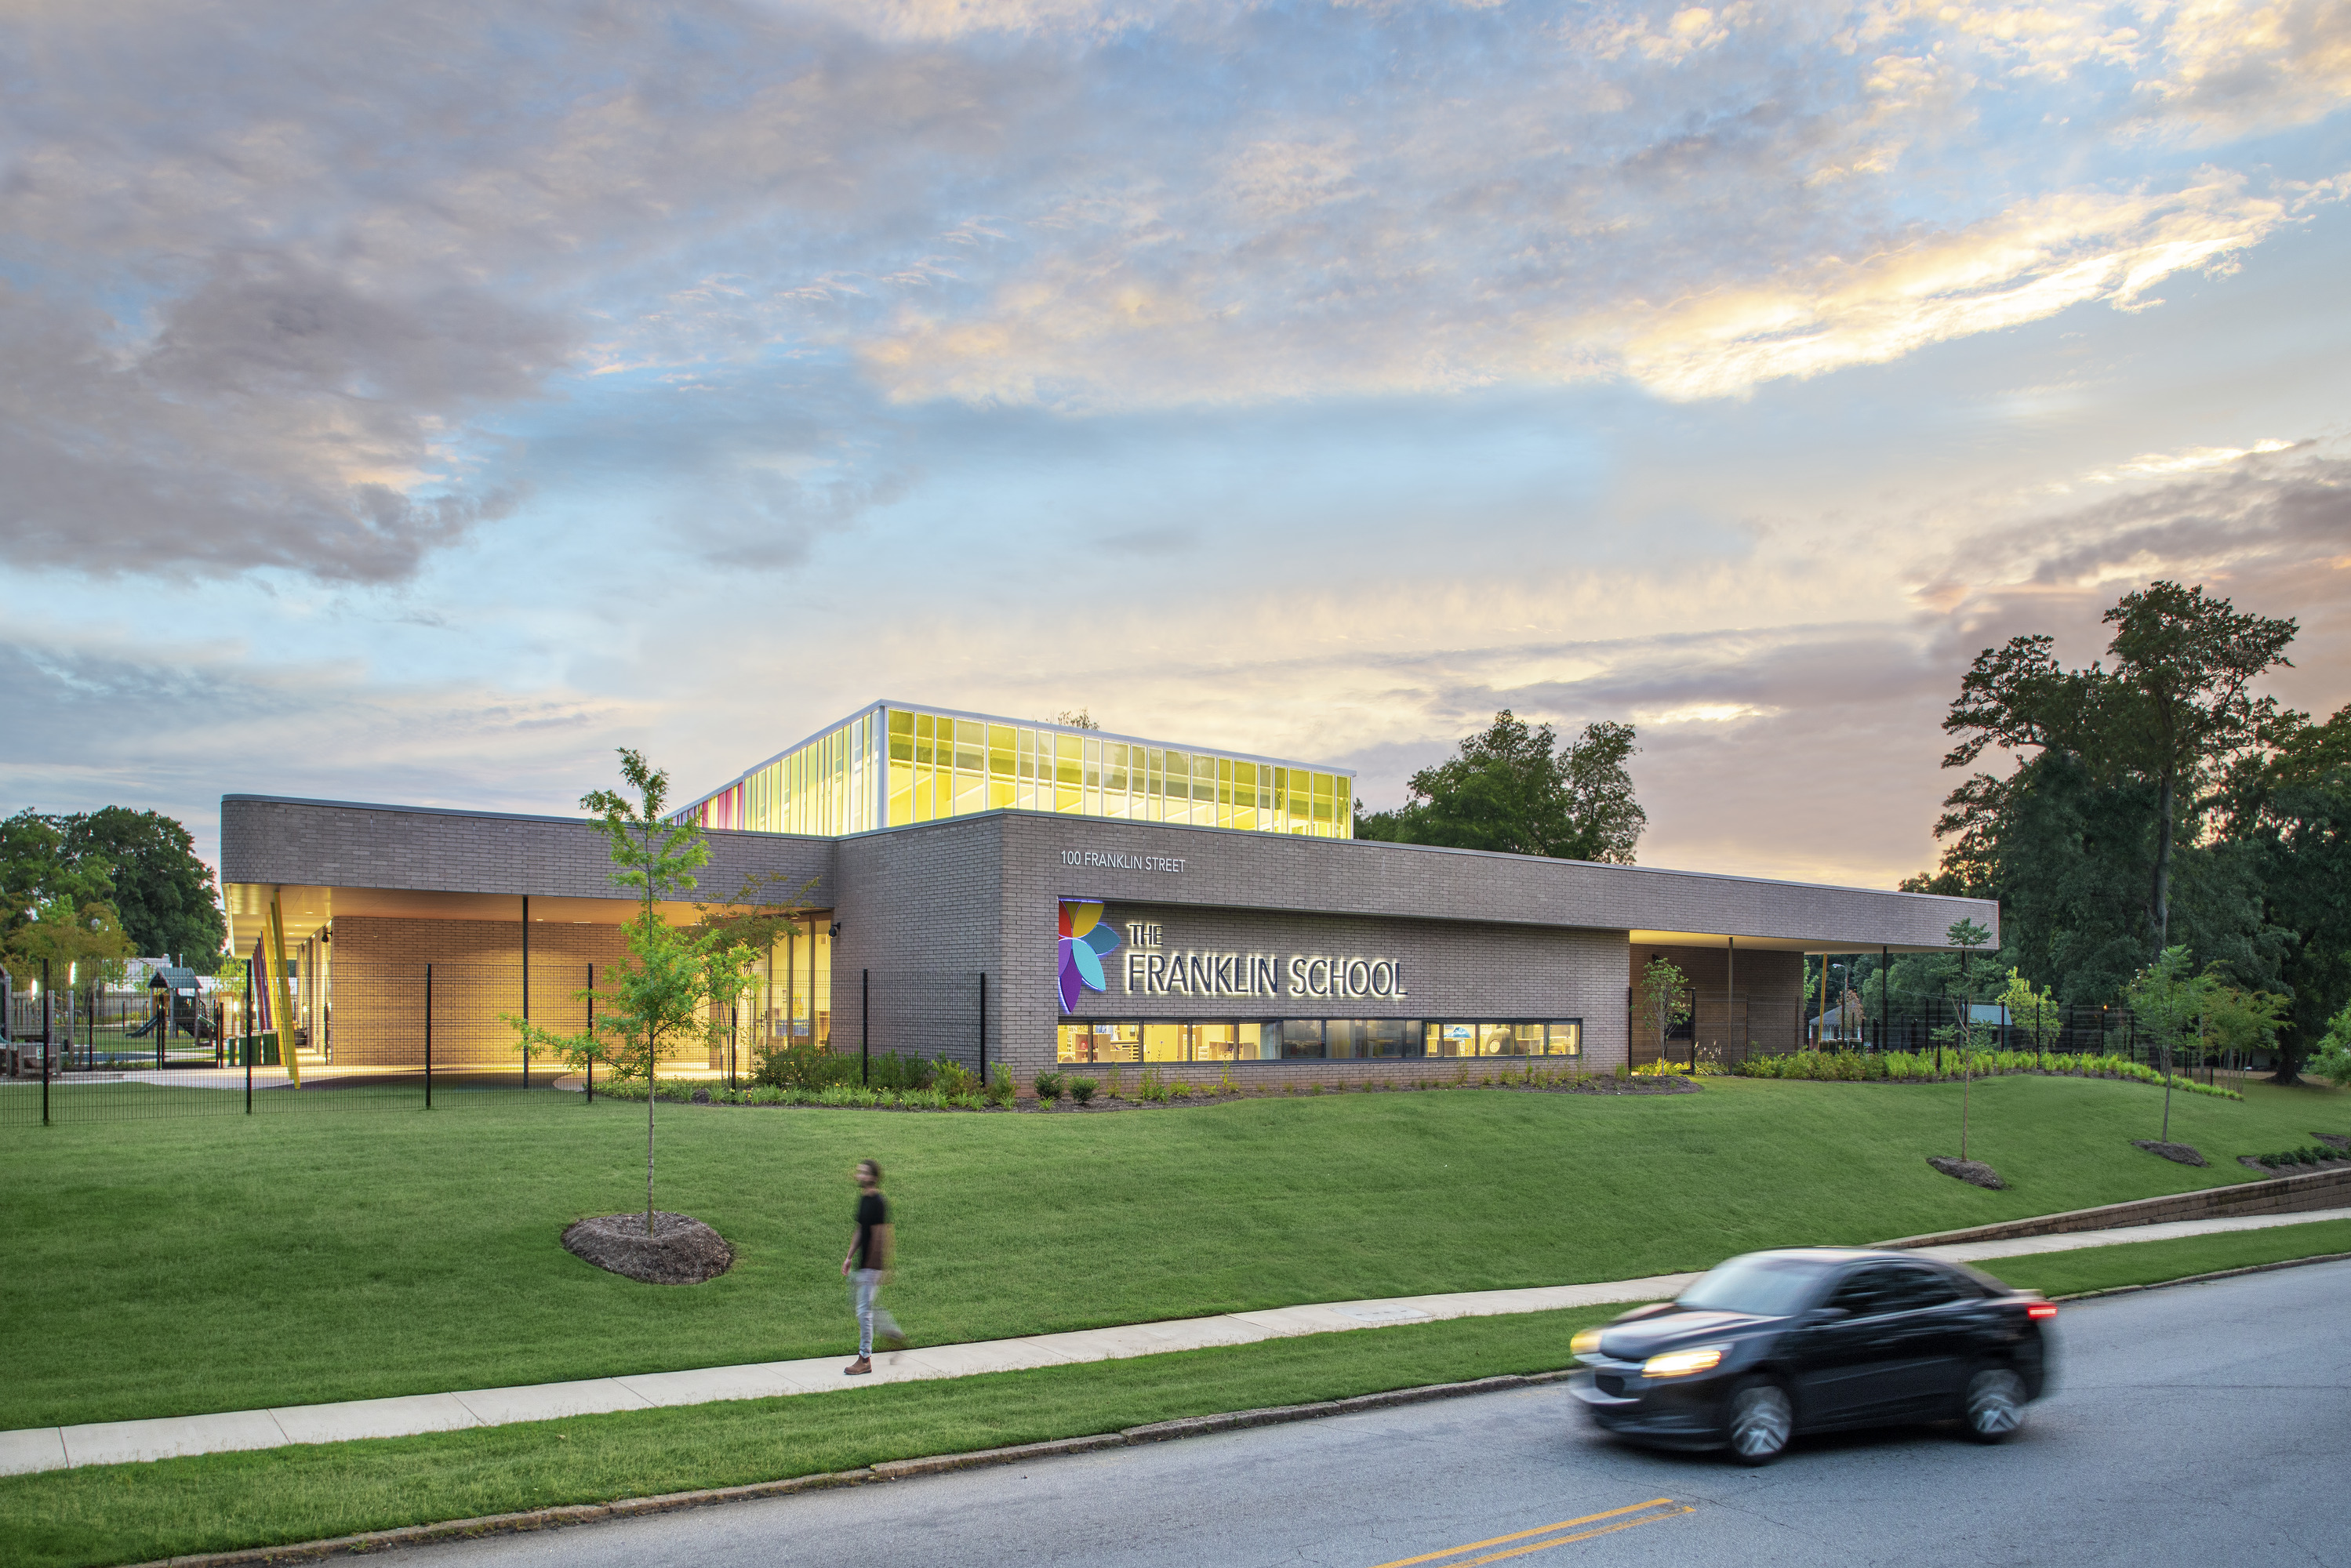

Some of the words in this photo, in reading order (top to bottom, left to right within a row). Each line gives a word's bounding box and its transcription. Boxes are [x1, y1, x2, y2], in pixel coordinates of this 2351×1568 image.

[1061, 850, 1081, 866] 100
[1085, 851, 1142, 869] FRANKLIN
[1145, 855, 1186, 873] STREET
[1128, 924, 1164, 946] THE
[1128, 953, 1278, 993] FRANKLIN
[1291, 958, 1408, 996] SCHOOL
